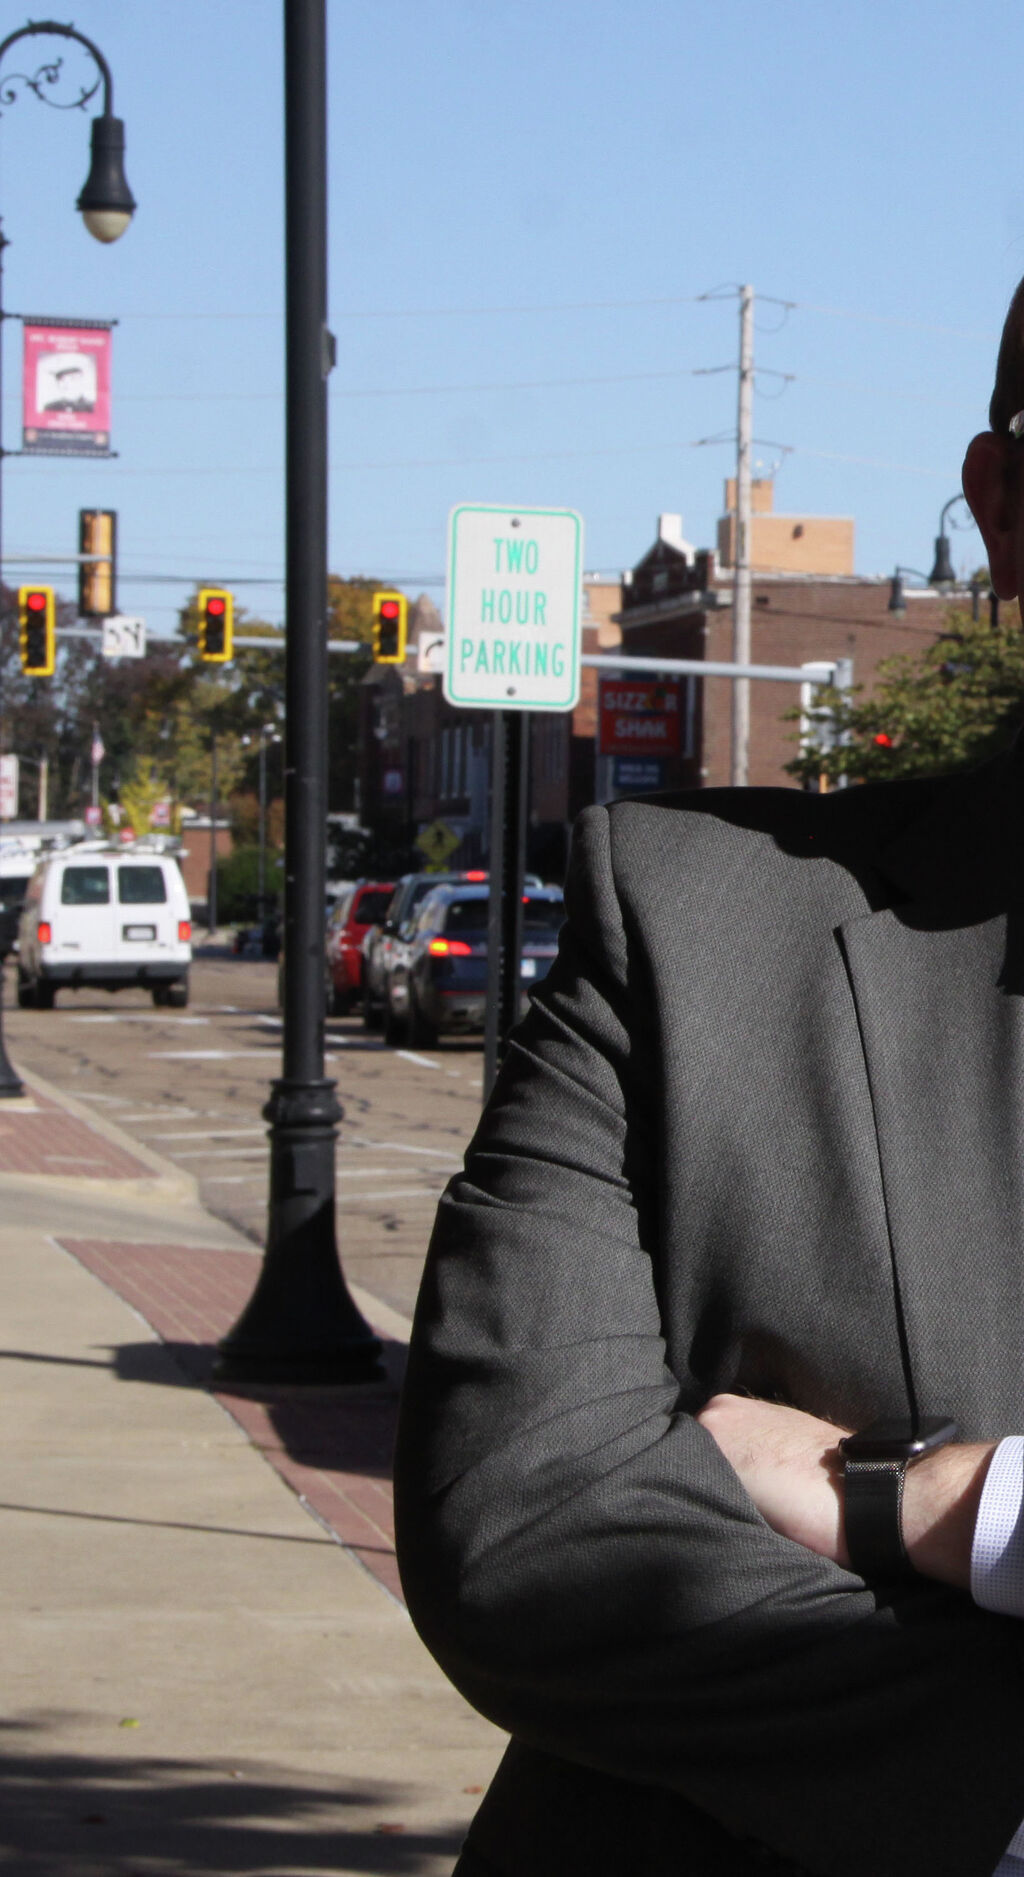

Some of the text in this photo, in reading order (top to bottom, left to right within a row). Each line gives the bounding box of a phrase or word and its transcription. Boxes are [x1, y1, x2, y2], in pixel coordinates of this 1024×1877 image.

[494, 538, 538, 574] TWO
[481, 588, 547, 625] HOUR
[461, 638, 565, 677] PARKING
